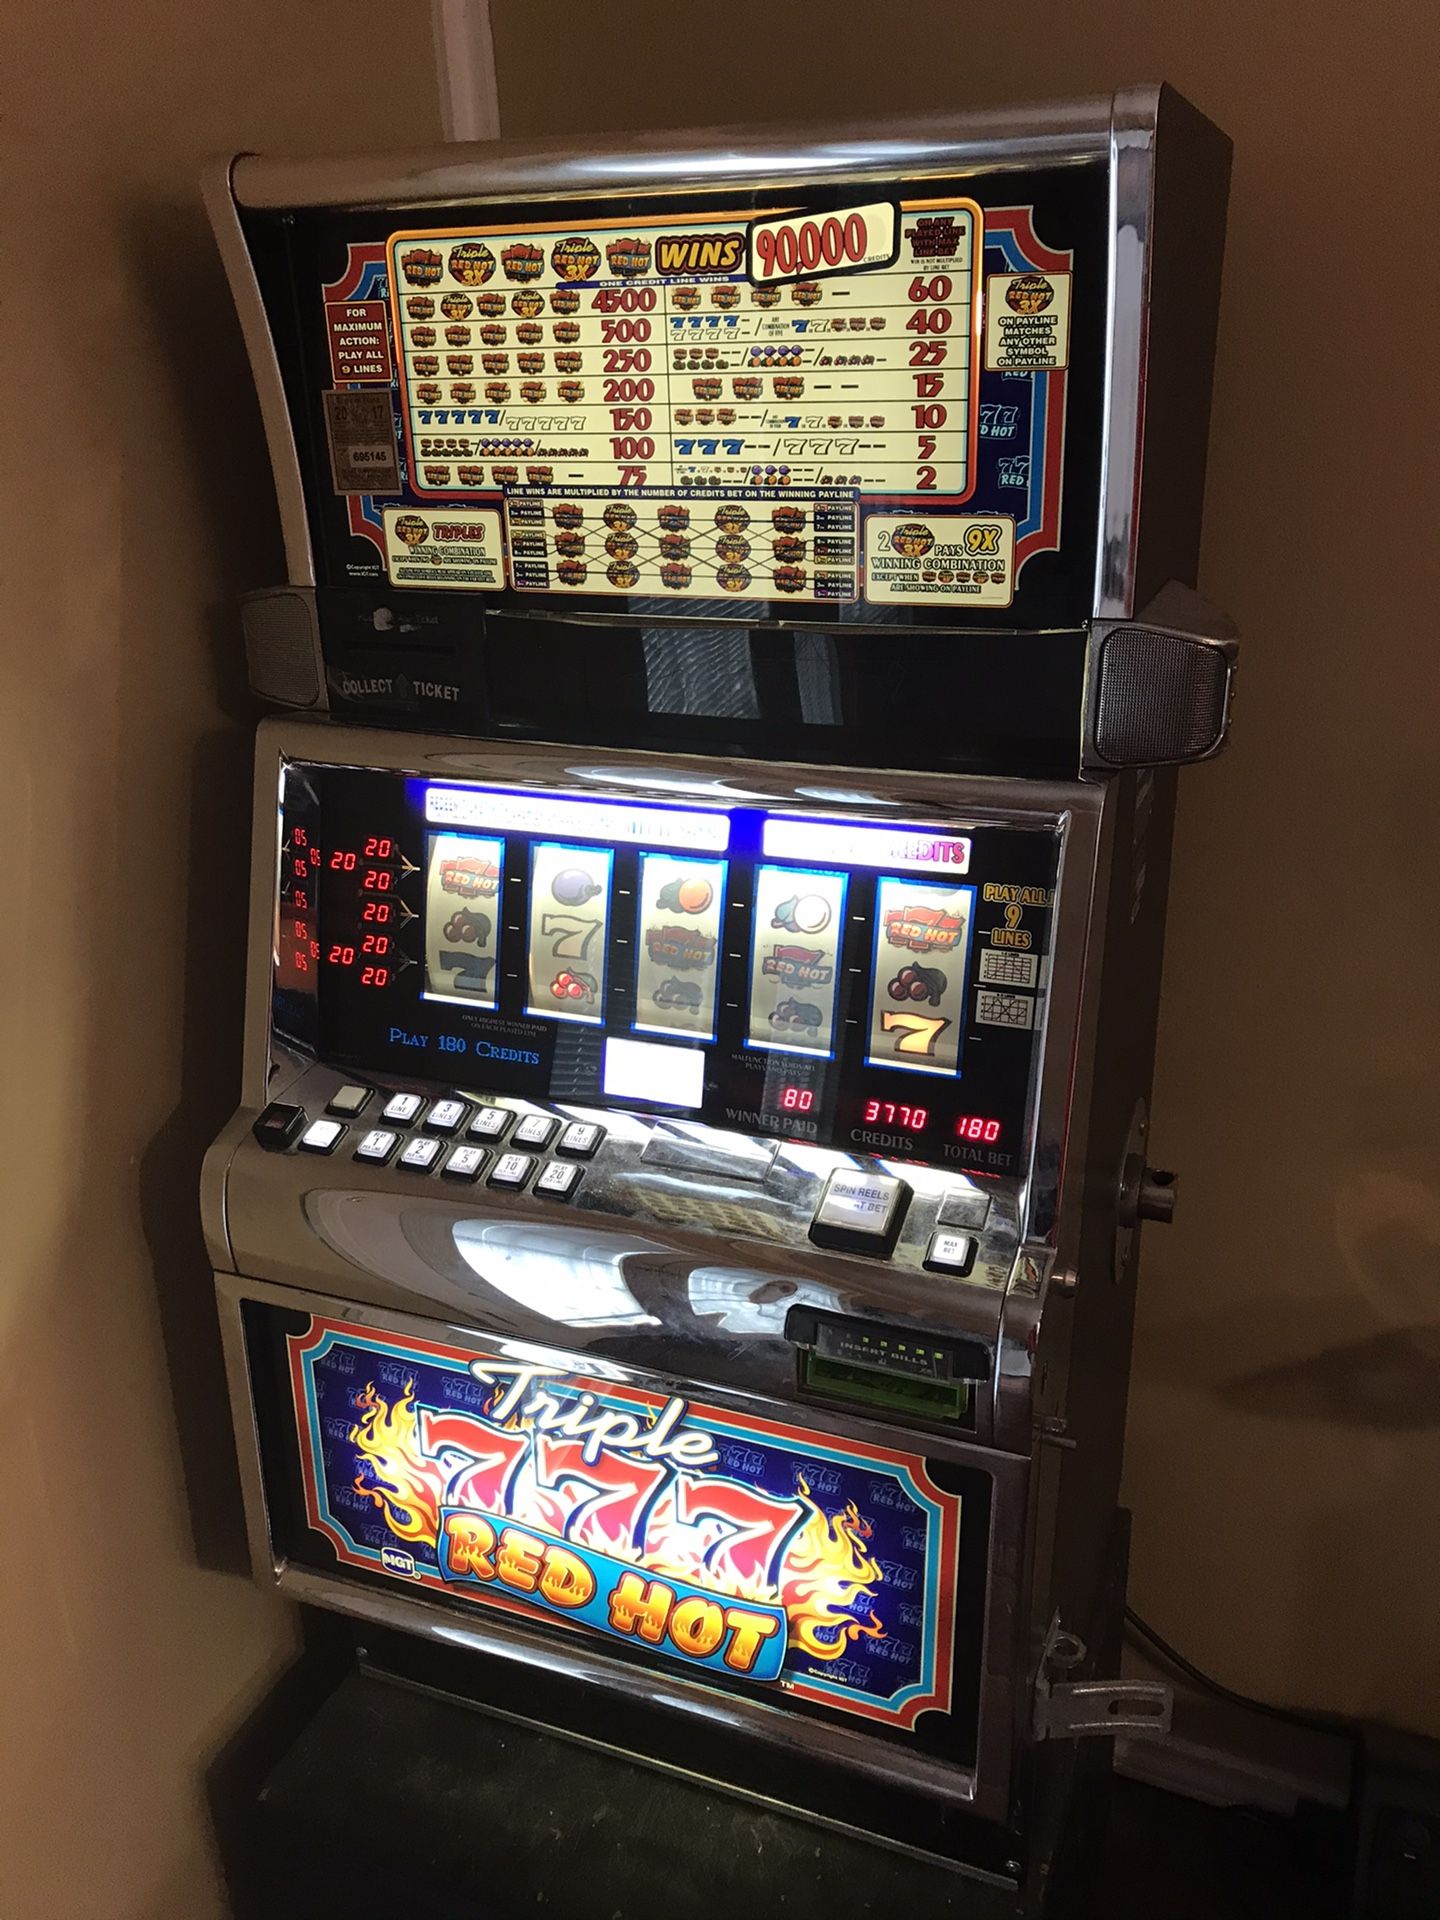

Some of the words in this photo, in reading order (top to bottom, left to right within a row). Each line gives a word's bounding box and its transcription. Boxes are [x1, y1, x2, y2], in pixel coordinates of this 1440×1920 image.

[917, 218, 931, 227] ON
[933, 217, 954, 226] ANY
[905, 229, 941, 238] PLAYED
[943, 227, 966, 236] LINE
[557, 238, 595, 254] Triple
[756, 212, 868, 277] 90,000
[912, 239, 936, 247] WITH
[937, 237, 959, 246] MAX
[554, 254, 575, 265] RED
[577, 254, 600, 266] HOT
[660, 240, 739, 269] WINS
[862, 253, 890, 263] CREDITS
[405, 264, 423, 275] RED
[425, 265, 442, 277] HOT
[564, 263, 588, 282] 3X
[908, 275, 953, 303] 60
[591, 287, 657, 313] 4500
[1019, 299, 1039, 314] 3X
[346, 308, 367, 317] FOR
[998, 316, 1014, 326] ON
[1016, 315, 1058, 325] PAYLINE
[333, 322, 383, 332] MAXIMUM
[906, 308, 953, 335] 40
[601, 318, 652, 344] 500
[1004, 326, 1051, 336] MATCHES
[339, 336, 380, 346] ACTION:
[999, 337, 1021, 346] ANY
[1022, 336, 1056, 345] OTHER
[338, 351, 363, 360] PLAY
[365, 350, 384, 359] ALL
[909, 341, 948, 367] 25
[1007, 347, 1047, 356] SYMBOL
[341, 365, 351, 374] 9
[353, 364, 383, 373] LINES
[602, 348, 653, 373] 250
[997, 357, 1014, 366] ON
[1015, 356, 1055, 366] PAYLINE
[603, 378, 655, 402] 200
[912, 372, 945, 398] 15
[609, 407, 653, 432] 150
[911, 404, 947, 429] 10
[609, 436, 655, 460] 100
[917, 435, 937, 459] 5
[617, 465, 648, 486] 75
[916, 465, 938, 490] 2
[506, 487, 524, 495] LINE
[525, 488, 546, 496] WINS
[547, 488, 563, 496] ARE
[564, 488, 610, 496] MULTIPLIED
[611, 489, 622, 497] BY
[623, 489, 639, 497] THE
[641, 489, 676, 497] NUMBER
[677, 489, 687, 497] OF
[690, 489, 725, 498] CREDITS
[727, 490, 743, 498] BET
[745, 490, 757, 498] ON
[759, 490, 776, 498] THE
[778, 490, 816, 499] WINNING
[818, 490, 855, 499] PAYLINE
[826, 514, 853, 522] PAYLINE
[433, 524, 484, 541] TRIPLES
[877, 530, 890, 552] 2
[968, 529, 998, 551] 9X
[903, 544, 924, 556] 3X
[934, 544, 963, 556] PAYS
[871, 557, 921, 569] WINNING
[923, 559, 1006, 571] COMBINATION
[342, 679, 393, 695] COLLECT
[413, 680, 460, 701] TICKET
[365, 838, 391, 858] 20
[330, 851, 356, 871] 20
[364, 870, 391, 890] 20
[444, 871, 469, 886] RED
[473, 873, 500, 890] HOT
[984, 883, 1021, 902] PLAY
[1021, 887, 1046, 906] ALL
[363, 903, 390, 923] 20
[1004, 904, 1022, 929] 9
[890, 920, 922, 939] RED
[923, 925, 959, 946] HOT
[992, 929, 1032, 949] LINES
[362, 935, 389, 955] 20
[652, 940, 679, 957] RED
[683, 948, 714, 962] HOT
[329, 946, 355, 965] 20
[361, 967, 388, 987] 20
[766, 958, 795, 974] RED
[798, 963, 830, 982] HOT
[438, 1034, 467, 1053] 180
[402, 1096, 409, 1105] 1
[783, 1088, 813, 1110] 80
[391, 1105, 407, 1113] LINE
[431, 1112, 453, 1120] LINES
[443, 1104, 452, 1113] 3
[486, 1111, 496, 1120] 5
[865, 1101, 927, 1130] 3770
[475, 1118, 498, 1129] LINES
[533, 1118, 541, 1127] 7
[726, 1108, 780, 1129] WINNER
[782, 1117, 818, 1134] PAID
[957, 1117, 1001, 1141] 180
[520, 1127, 543, 1137] LINES
[565, 1135, 588, 1144] LINES
[577, 1127, 586, 1136] 9
[850, 1128, 913, 1150] CREDITS
[373, 1138, 381, 1146] 1
[415, 1145, 424, 1154] 2
[461, 1155, 470, 1164] 5
[943, 1144, 985, 1163] TOTAL
[987, 1152, 1014, 1167] BET
[505, 1161, 518, 1171] 10
[549, 1170, 563, 1181] 20
[833, 1184, 857, 1195] SPIN
[857, 1187, 890, 1201] REELS
[867, 1203, 888, 1214] BET
[943, 1240, 958, 1248] MAX
[840, 1341, 887, 1357] INSERT
[890, 1352, 929, 1367] BILLS
[446, 1390, 463, 1400] RED
[464, 1395, 482, 1405] HOT
[469, 1358, 719, 1466] Triple
[443, 1512, 598, 1609] RED
[608, 1570, 780, 1673] HOT
[780, 1679, 795, 1690] TM
